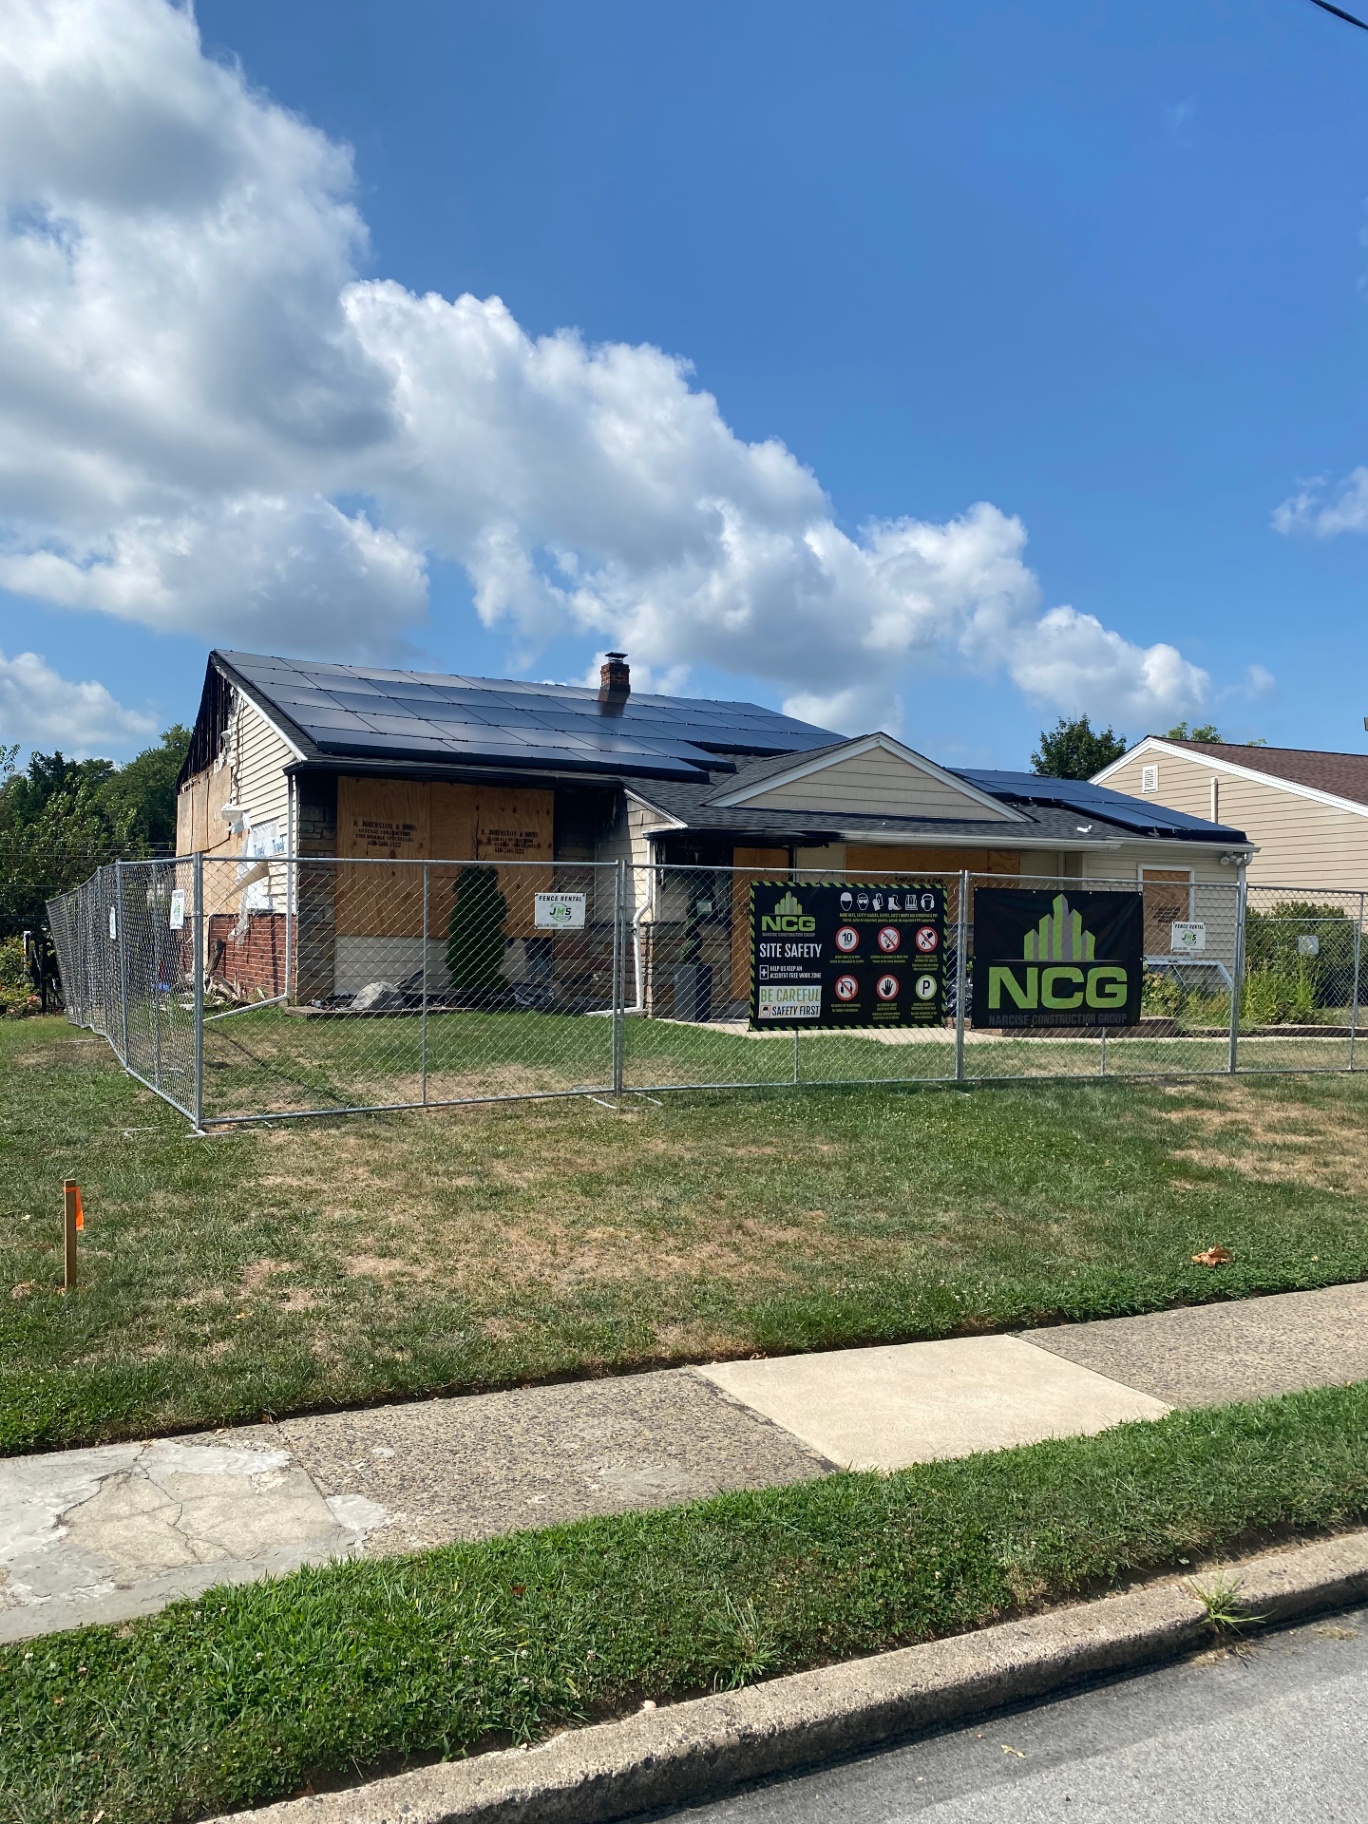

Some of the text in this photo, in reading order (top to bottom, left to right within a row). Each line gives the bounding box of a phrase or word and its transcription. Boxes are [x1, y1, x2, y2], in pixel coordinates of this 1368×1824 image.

[549, 907, 572, 916] JMS
[761, 915, 816, 932] NCG
[842, 932, 852, 943] 10
[760, 943, 822, 958] SITE SAFETY
[922, 980, 930, 995] P
[988, 966, 1128, 1009] NCG
[760, 988, 820, 1002] BE CAREFUL
[772, 1005, 798, 1016] SAFETY
[799, 1005, 820, 1016] FIRST
[988, 1013, 1128, 1026] NARCISE CONSTRUCTION GROUP
